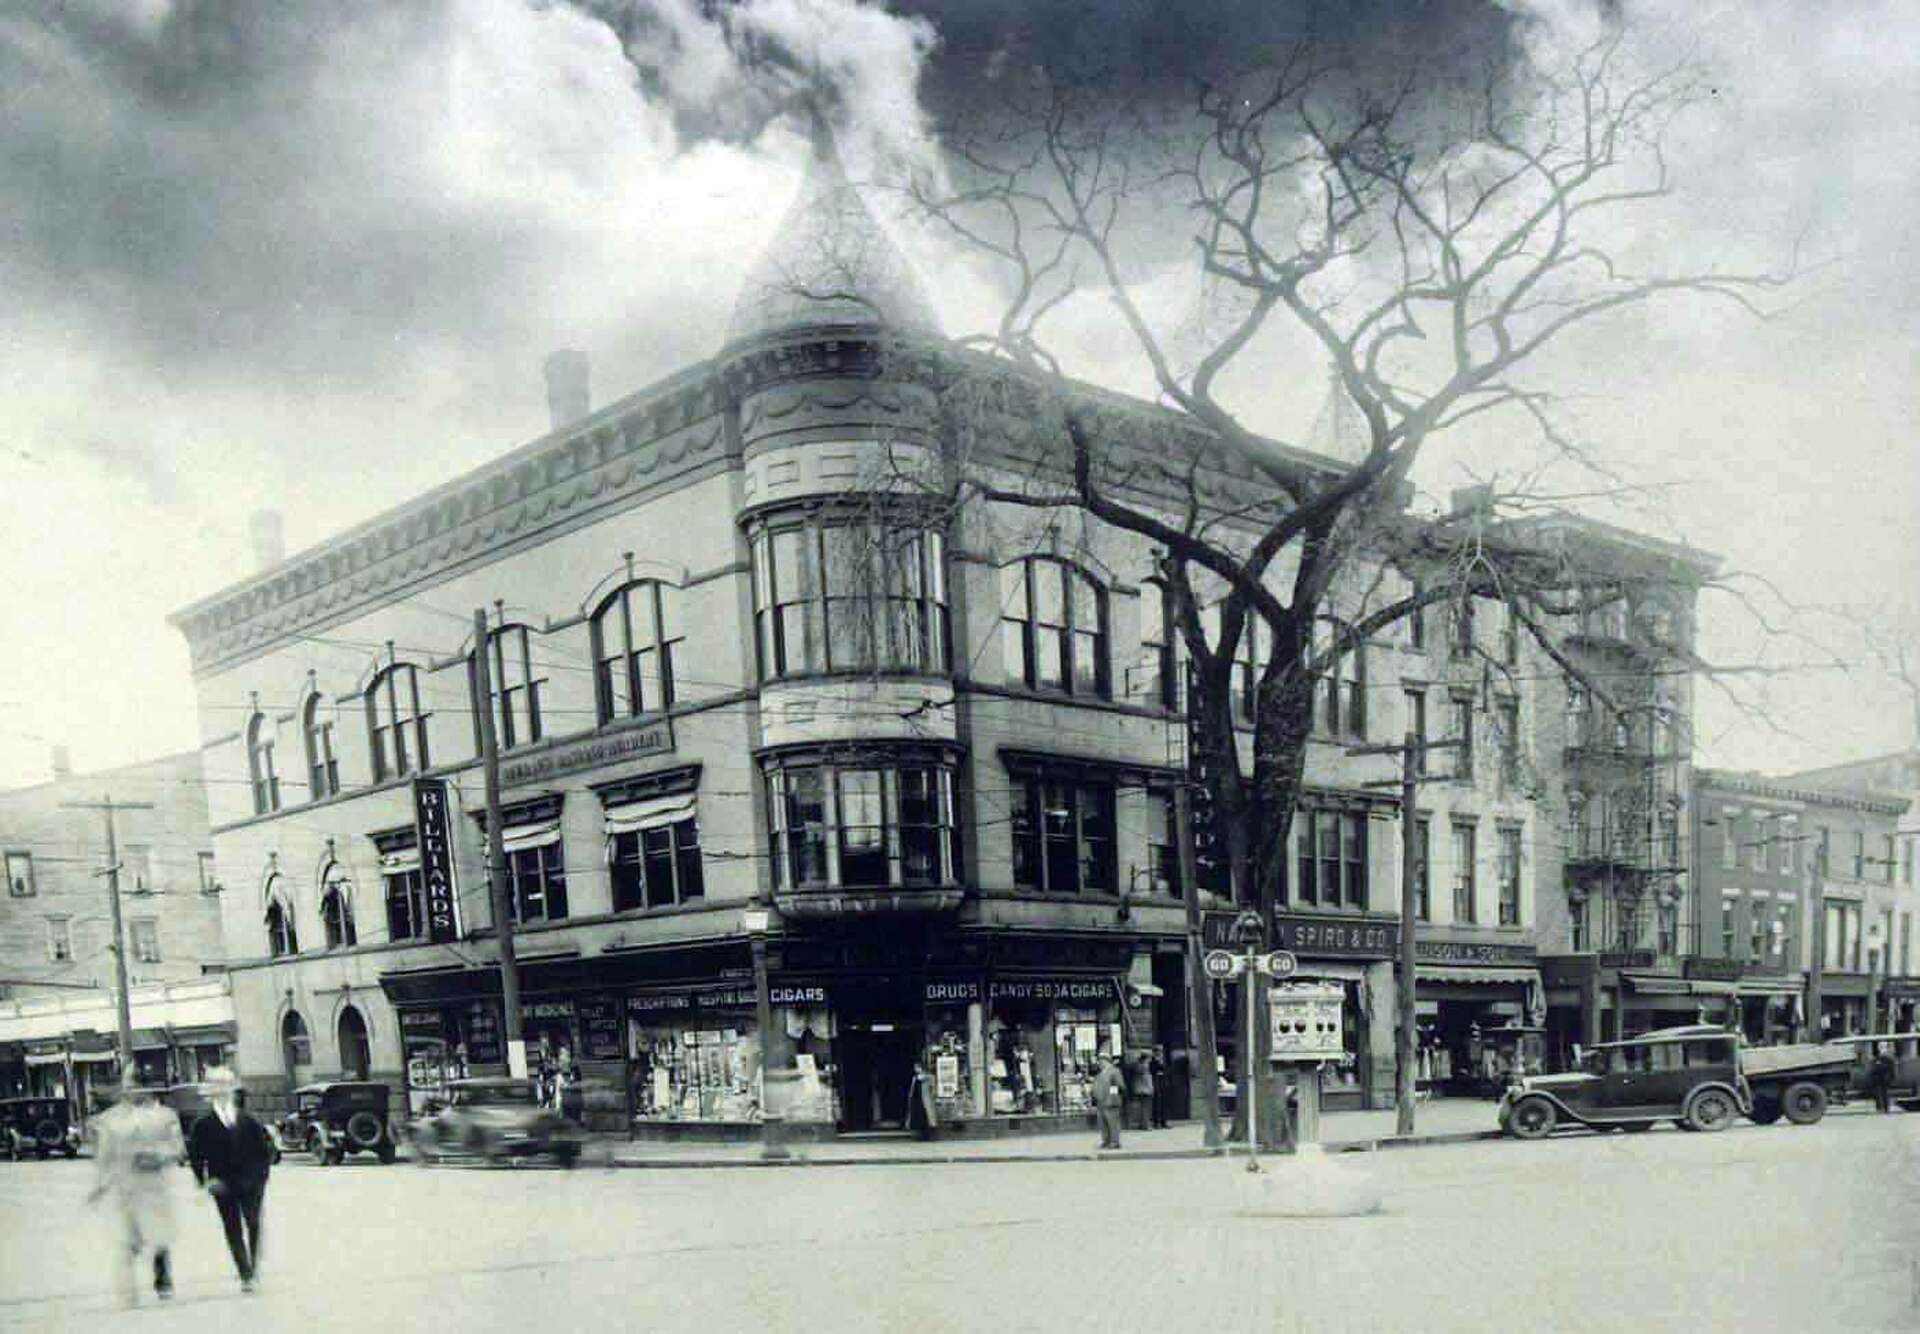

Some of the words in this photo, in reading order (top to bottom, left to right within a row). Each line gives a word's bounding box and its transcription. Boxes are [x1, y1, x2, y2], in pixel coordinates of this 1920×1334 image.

[422, 791, 449, 928] BILLIARDS
[1295, 926, 1345, 947] SPIRO
[1351, 929, 1360, 948] &
[1210, 957, 1230, 971] GO
[1272, 957, 1291, 971] GO
[770, 987, 825, 1003] CIGARS
[926, 983, 978, 999] DRUGS
[989, 983, 1033, 999] CANDY
[1034, 983, 1069, 998] SODA
[1070, 983, 1114, 998] CIGARS
